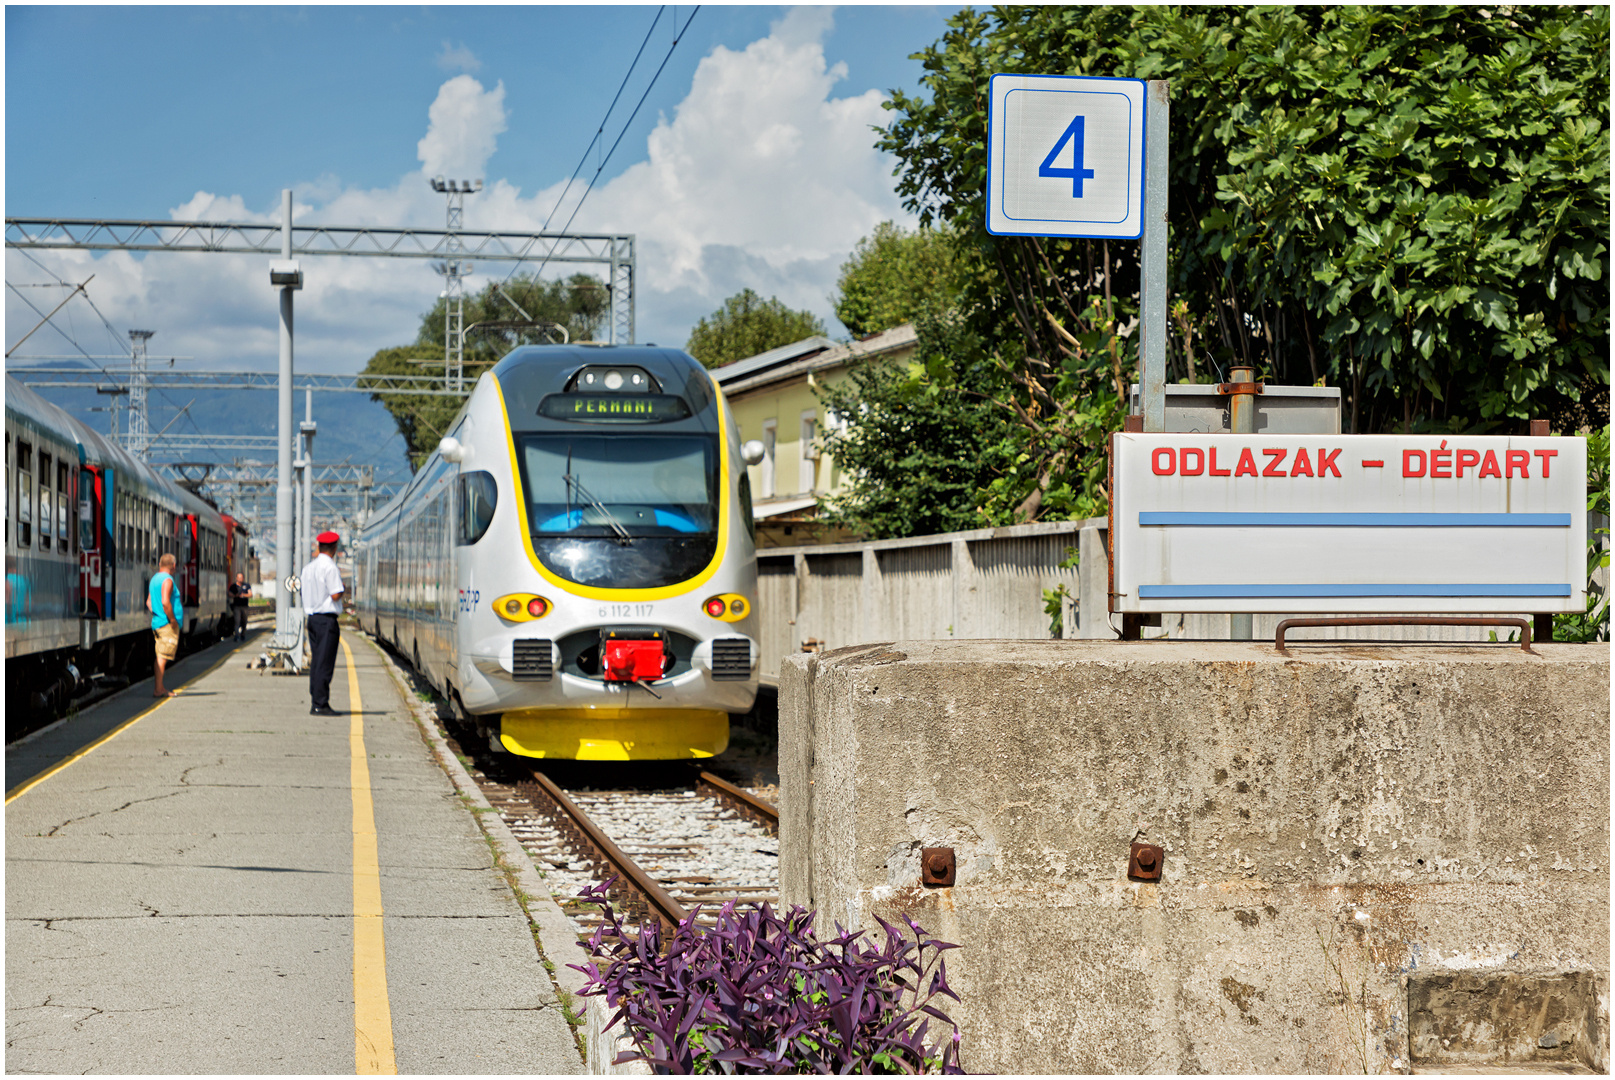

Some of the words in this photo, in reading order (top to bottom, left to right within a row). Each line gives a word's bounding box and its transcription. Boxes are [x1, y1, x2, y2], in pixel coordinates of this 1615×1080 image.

[1038, 115, 1095, 199] 4
[574, 399, 653, 414] PERMANI
[1151, 446, 1343, 478] ODLAZAK
[1402, 438, 1559, 479] DÉPART
[598, 605, 607, 618] 6
[611, 604, 632, 618] 112
[635, 604, 654, 617] 117
